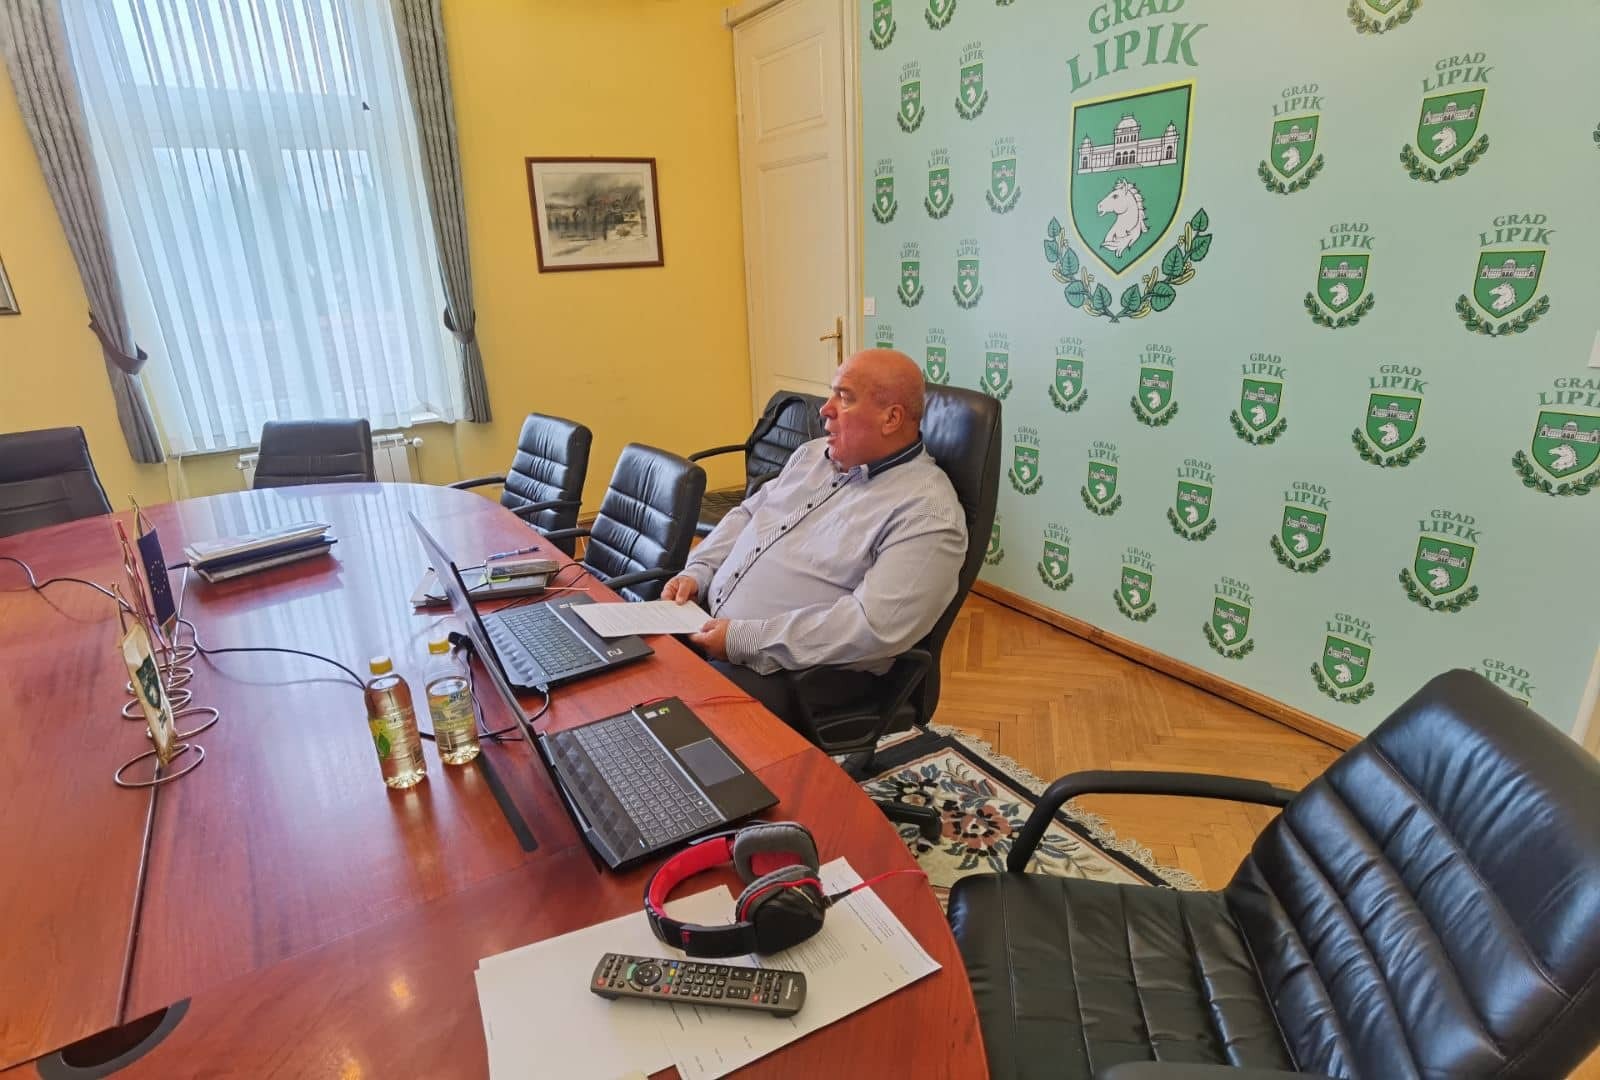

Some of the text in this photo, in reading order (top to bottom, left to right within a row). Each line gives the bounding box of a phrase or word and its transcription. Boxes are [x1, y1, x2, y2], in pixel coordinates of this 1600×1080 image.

[959, 50, 984, 65] LIPIK
[1066, 22, 1208, 94] LIPIK
[1435, 52, 1486, 72] GRAD
[1421, 66, 1495, 93] LIPIK
[1281, 83, 1319, 99] GRAD
[1272, 95, 1326, 117] LIPIK
[928, 156, 951, 168] LIPIK
[1493, 213, 1547, 227] GRAD
[1329, 223, 1369, 234] GRAD
[1319, 234, 1376, 251] LIPIK
[1479, 227, 1557, 248] LIPIK
[956, 246, 980, 257] LIPIK
[1060, 336, 1082, 345] GRAD
[1055, 344, 1085, 358] LIPIK
[1145, 343, 1173, 354] GRAD
[1139, 353, 1176, 367] LIPIK
[1250, 352, 1282, 364] GRAD
[1242, 363, 1287, 379] LIPIK
[1380, 364, 1422, 377] GRAD
[1369, 375, 1428, 394] LIPIK
[1553, 377, 1600, 390] GRA
[1536, 391, 1600, 408] LIPI
[1018, 426, 1038, 435] GRAD
[1013, 434, 1040, 446] LIPIK
[1093, 440, 1117, 451] GRAD
[1088, 449, 1120, 463] LIPIK
[1184, 458, 1212, 471] GRAD
[1177, 466, 1216, 485] LIPIK
[1292, 481, 1326, 496] GRAD
[1284, 490, 1332, 511] LIPIK
[1430, 508, 1475, 526] GRAD
[1048, 522, 1068, 533] GRAD
[1418, 518, 1483, 544] LIPIK
[1043, 530, 1071, 545] LIPIK
[1127, 547, 1151, 559] GRAD
[1121, 554, 1156, 572] LIPIK
[1221, 576, 1250, 591] GRAD
[1214, 583, 1255, 606] LIPIK
[1335, 612, 1371, 631] GRAD
[1326, 620, 1376, 647] LIPIK
[1482, 658, 1530, 679] GRAD
[1472, 667, 1536, 697] IPIK
